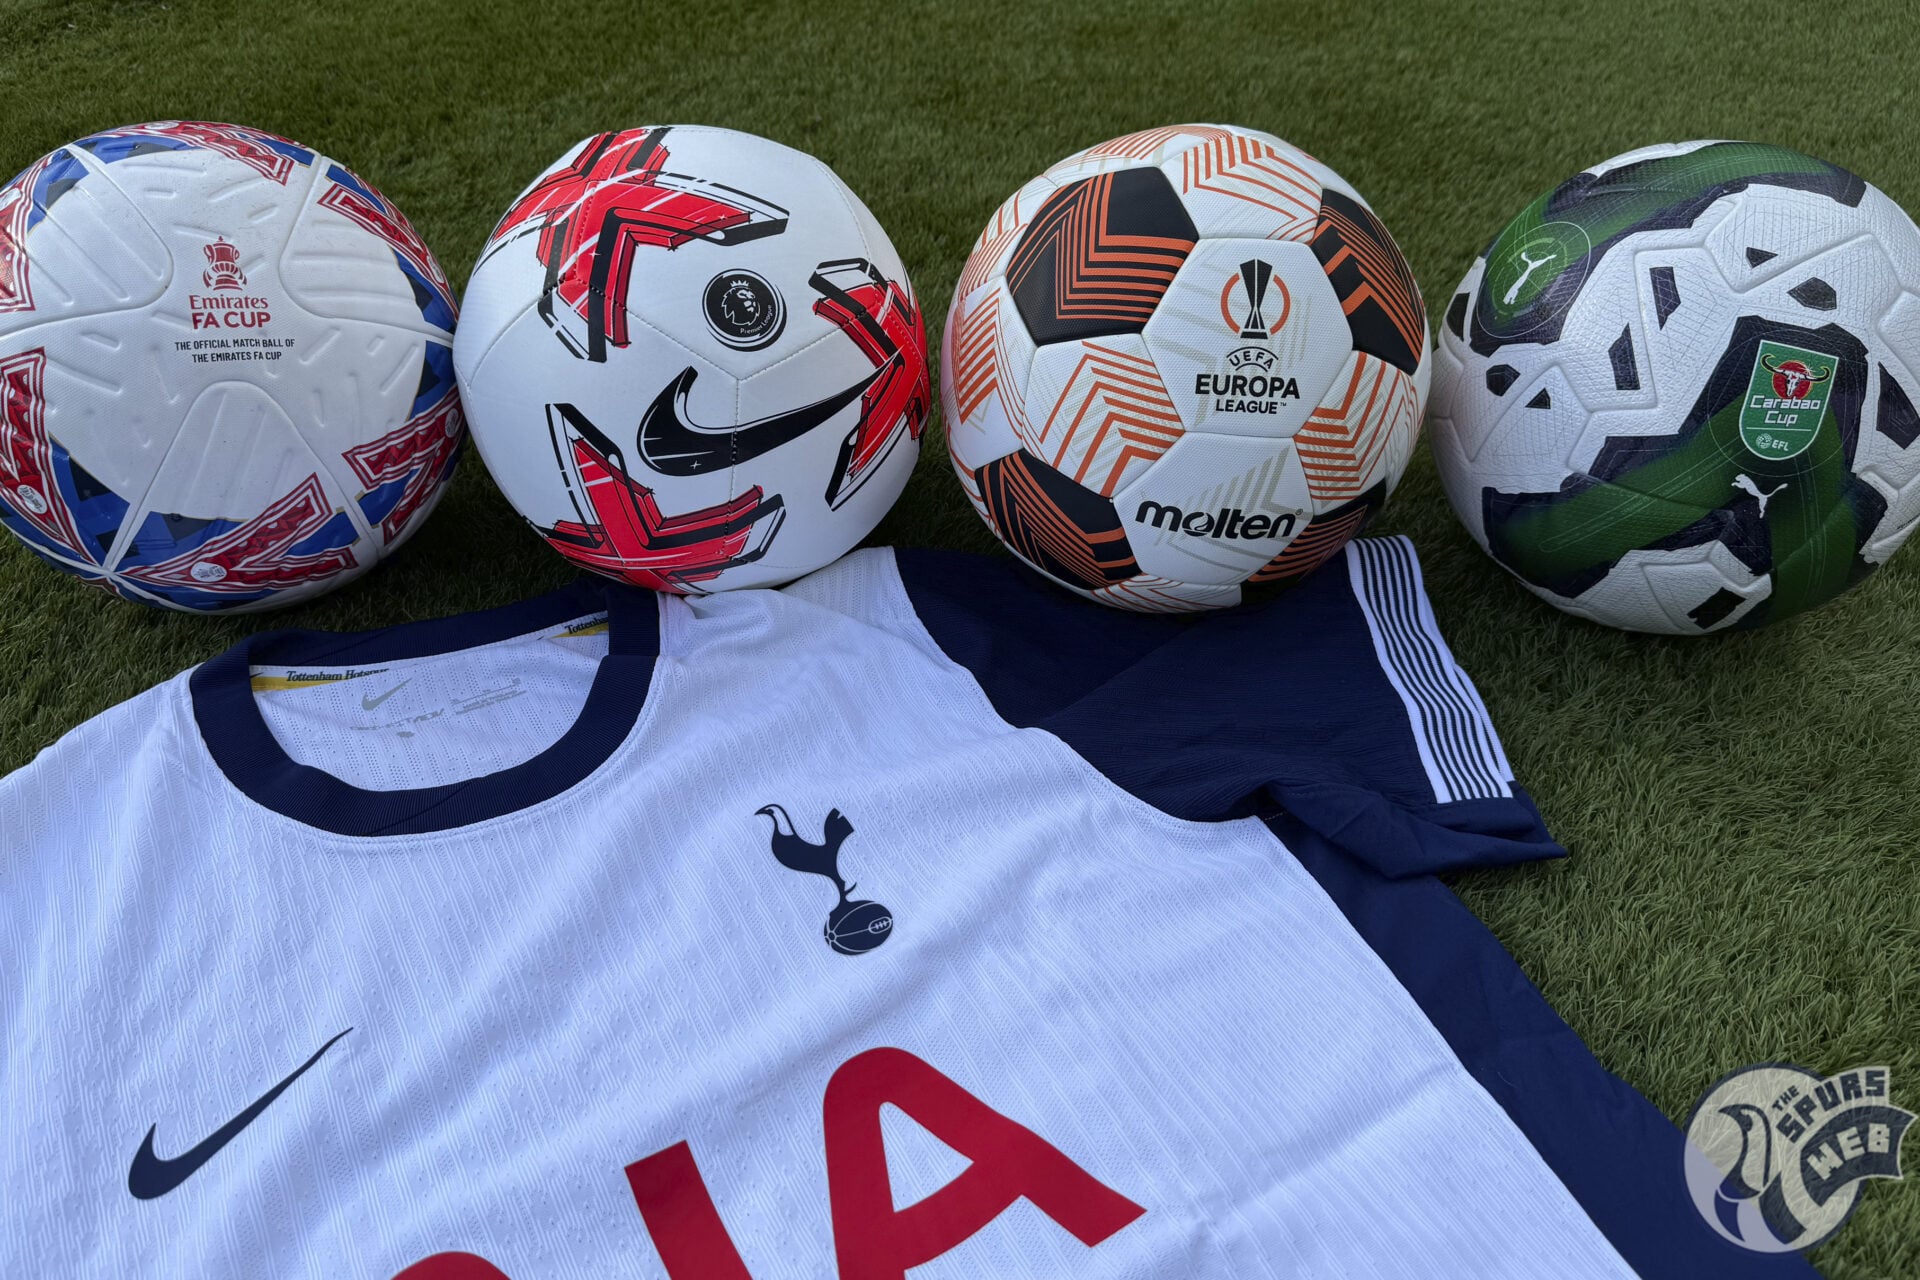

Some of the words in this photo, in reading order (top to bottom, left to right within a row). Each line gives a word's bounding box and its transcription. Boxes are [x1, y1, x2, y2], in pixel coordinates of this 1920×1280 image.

[189, 294, 269, 310] Emirates
[192, 312, 220, 330] FA
[223, 311, 271, 328] CUP
[740, 324, 763, 334] Premier
[760, 304, 773, 326] League
[175, 342, 191, 351] THE
[194, 339, 231, 349] OFFICIAL
[233, 338, 260, 348] MATCH
[263, 338, 283, 348] BALL
[285, 338, 295, 347] OF
[192, 354, 208, 363] THE
[211, 352, 252, 362] EMIRATES
[254, 352, 264, 360] FA
[266, 351, 282, 360] CUP
[1229, 350, 1274, 369] UEFA
[1195, 374, 1300, 399] EUROPA
[1750, 395, 1821, 410] Carabao
[1764, 411, 1798, 427] Cup
[1771, 440, 1789, 452] EFL
[564, 617, 608, 634] Tottenha
[286, 671, 342, 682] Tottenham
